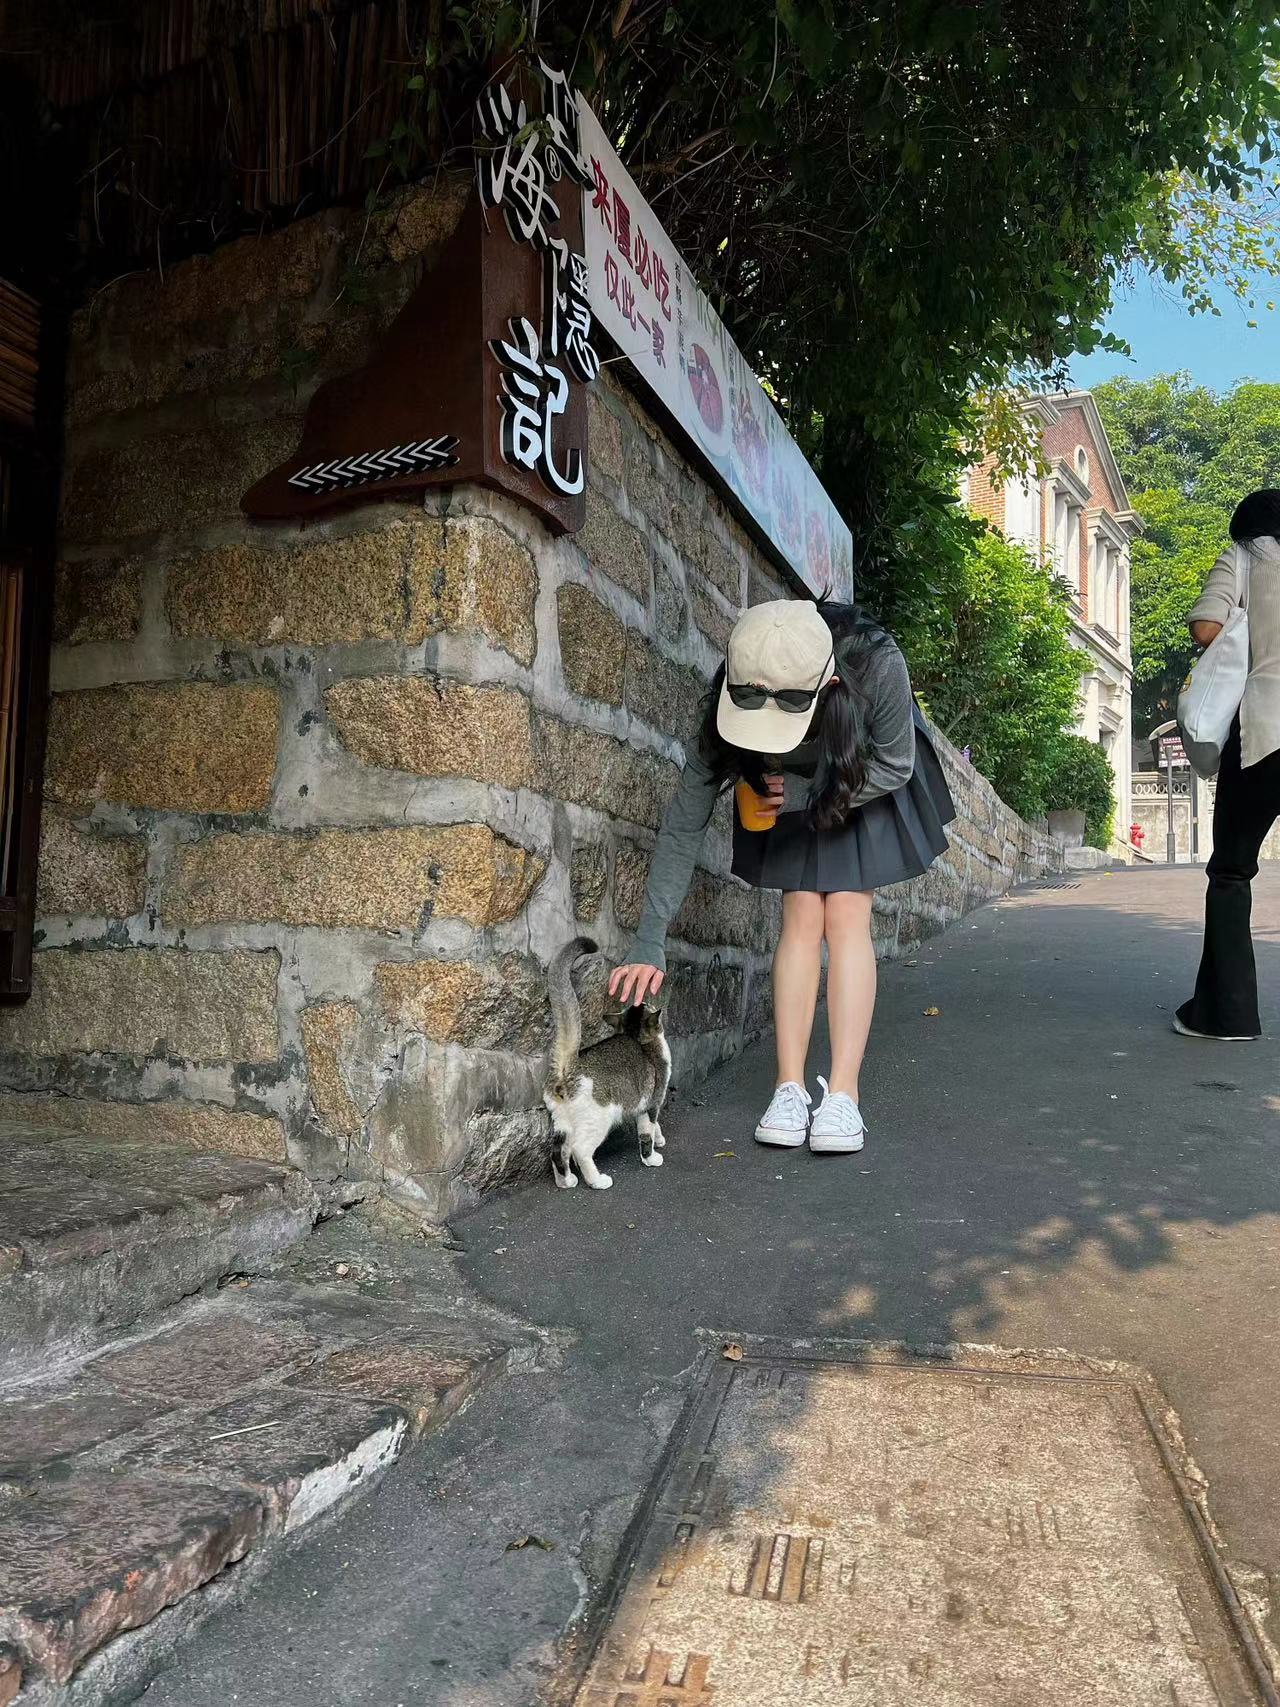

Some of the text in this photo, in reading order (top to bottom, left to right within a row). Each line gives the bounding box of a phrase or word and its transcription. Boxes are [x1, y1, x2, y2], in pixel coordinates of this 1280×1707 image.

[590, 153, 672, 323] 来厦必吃
[604, 250, 666, 370] 仅此一家
